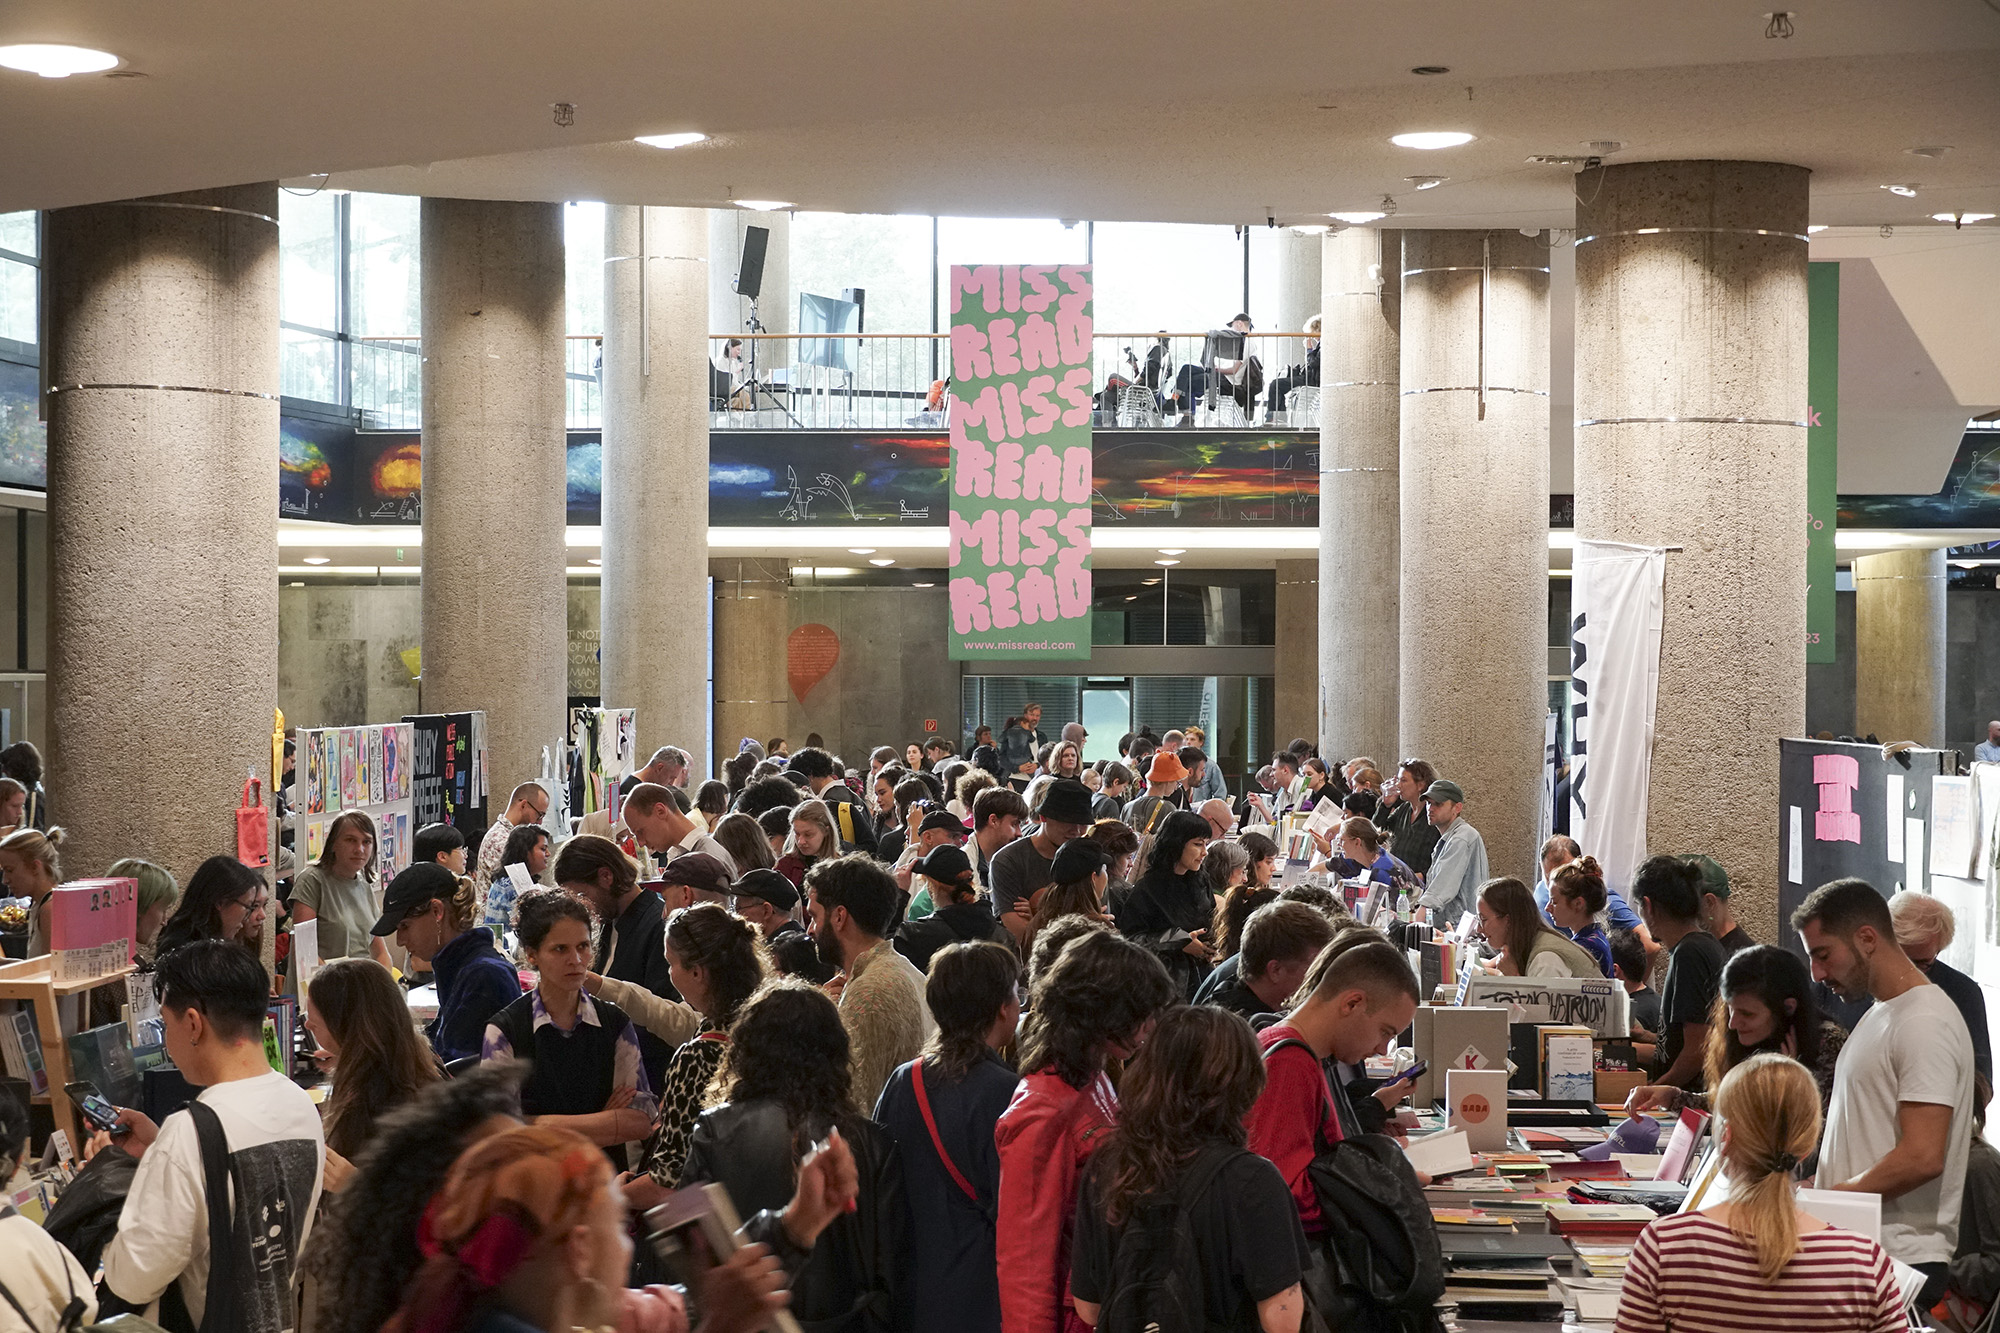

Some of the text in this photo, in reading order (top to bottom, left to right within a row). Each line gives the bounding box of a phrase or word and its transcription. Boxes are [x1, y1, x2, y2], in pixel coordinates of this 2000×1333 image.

[951, 265, 1092, 313] MISS
[951, 309, 1092, 381] READ
[950, 367, 1092, 449] MISS
[955, 440, 1092, 503] READ
[949, 509, 1092, 566] MISS
[949, 561, 1092, 635] READ
[963, 639, 1076, 652] www.missread.com
[413, 728, 439, 776] RUBY
[413, 776, 442, 825] PRESS
